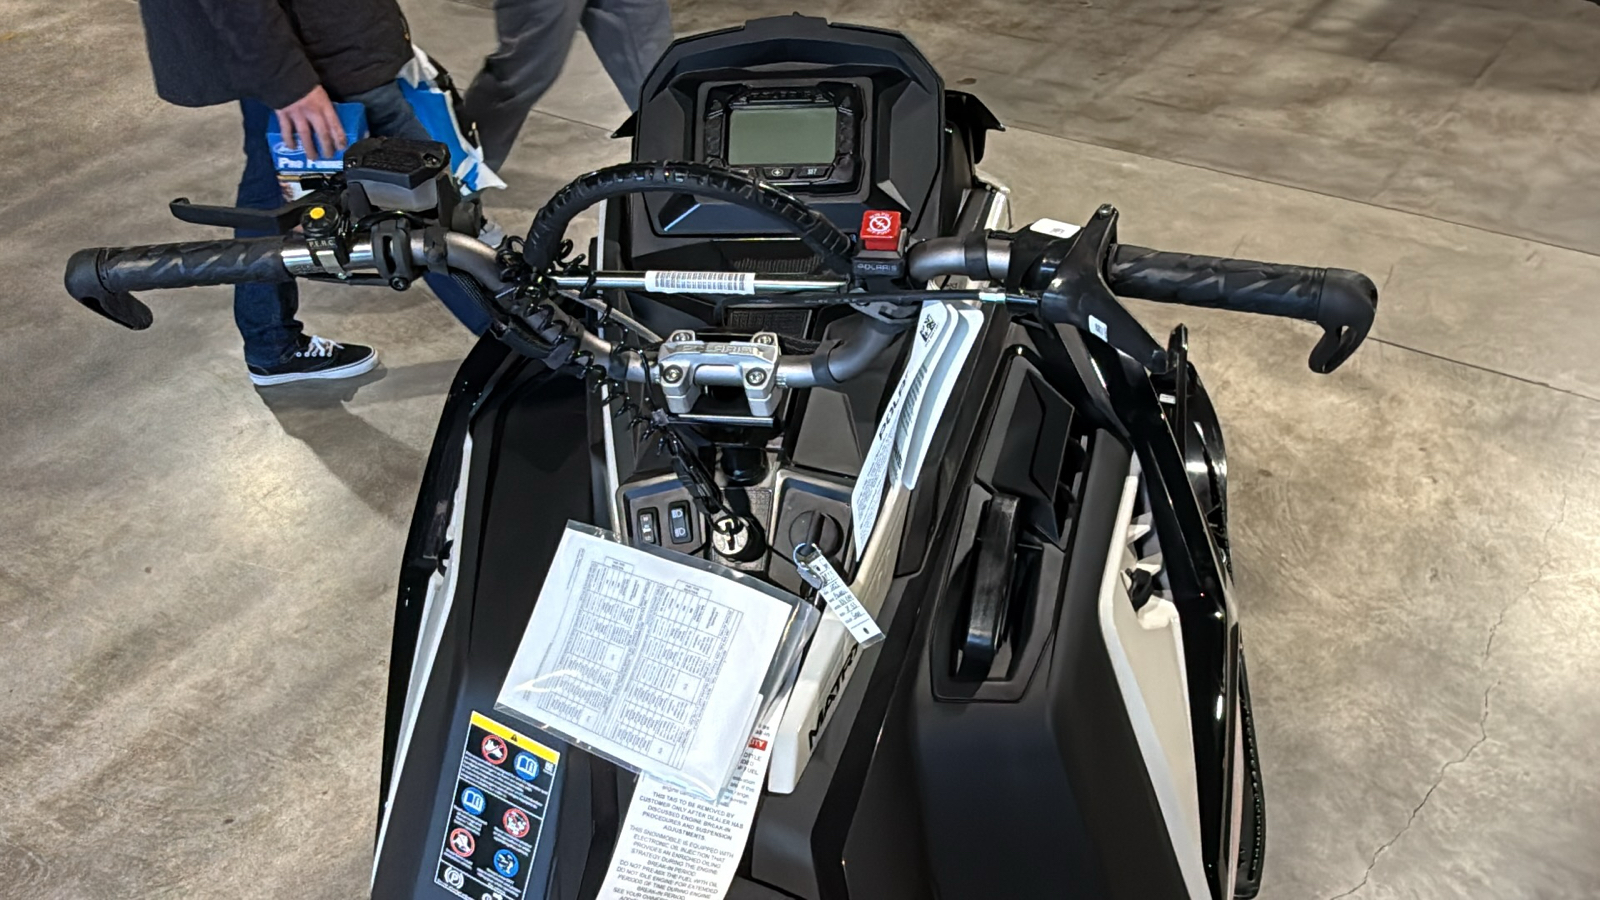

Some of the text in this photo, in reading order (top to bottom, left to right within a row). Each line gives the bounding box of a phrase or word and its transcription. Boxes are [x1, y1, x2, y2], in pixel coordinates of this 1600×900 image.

[857, 263, 898, 272] POLARIS
[639, 795, 670, 807] CUSTOMER
[671, 804, 687, 812] ONLY
[687, 808, 706, 818] AFTER
[706, 814, 730, 824] DEALER
[647, 804, 680, 818] DISCUSSED
[680, 814, 701, 824] ENGINE
[652, 791, 665, 799] THIS
[696, 803, 725, 816] REMOVED
[641, 810, 681, 825] PROCEDURES
[695, 826, 732, 840] SUSPENSION
[629, 824, 643, 832] THIS
[643, 828, 681, 844] SNOWMOBILE
[688, 841, 718, 854] EQUIPPED
[718, 849, 734, 858] WITH
[632, 840, 662, 853] PROVIDES
[671, 851, 701, 864] ENRICHED
[701, 859, 721, 869] OILING
[633, 833, 669, 848] ELECTRONIC
[679, 846, 710, 859] INJECTION
[710, 854, 725, 863] THAT
[629, 861, 641, 869] NOT
[666, 871, 677, 879] THE
[677, 874, 692, 882] FUEL
[693, 877, 708, 886] WITH
[630, 847, 717, 875] STRATEGY DURING THE ENGINE
[612, 886, 624, 894] SEE
[625, 888, 641, 898] YOUR
[625, 868, 638, 876] NOT
[638, 871, 651, 879] IDLE
[652, 874, 673, 885] ENGINE
[674, 879, 687, 888] FOR
[686, 881, 718, 895] EXTENDED
[652, 881, 665, 890] TIME
[666, 884, 689, 896] DURING
[689, 889, 711, 900] ENGINE
